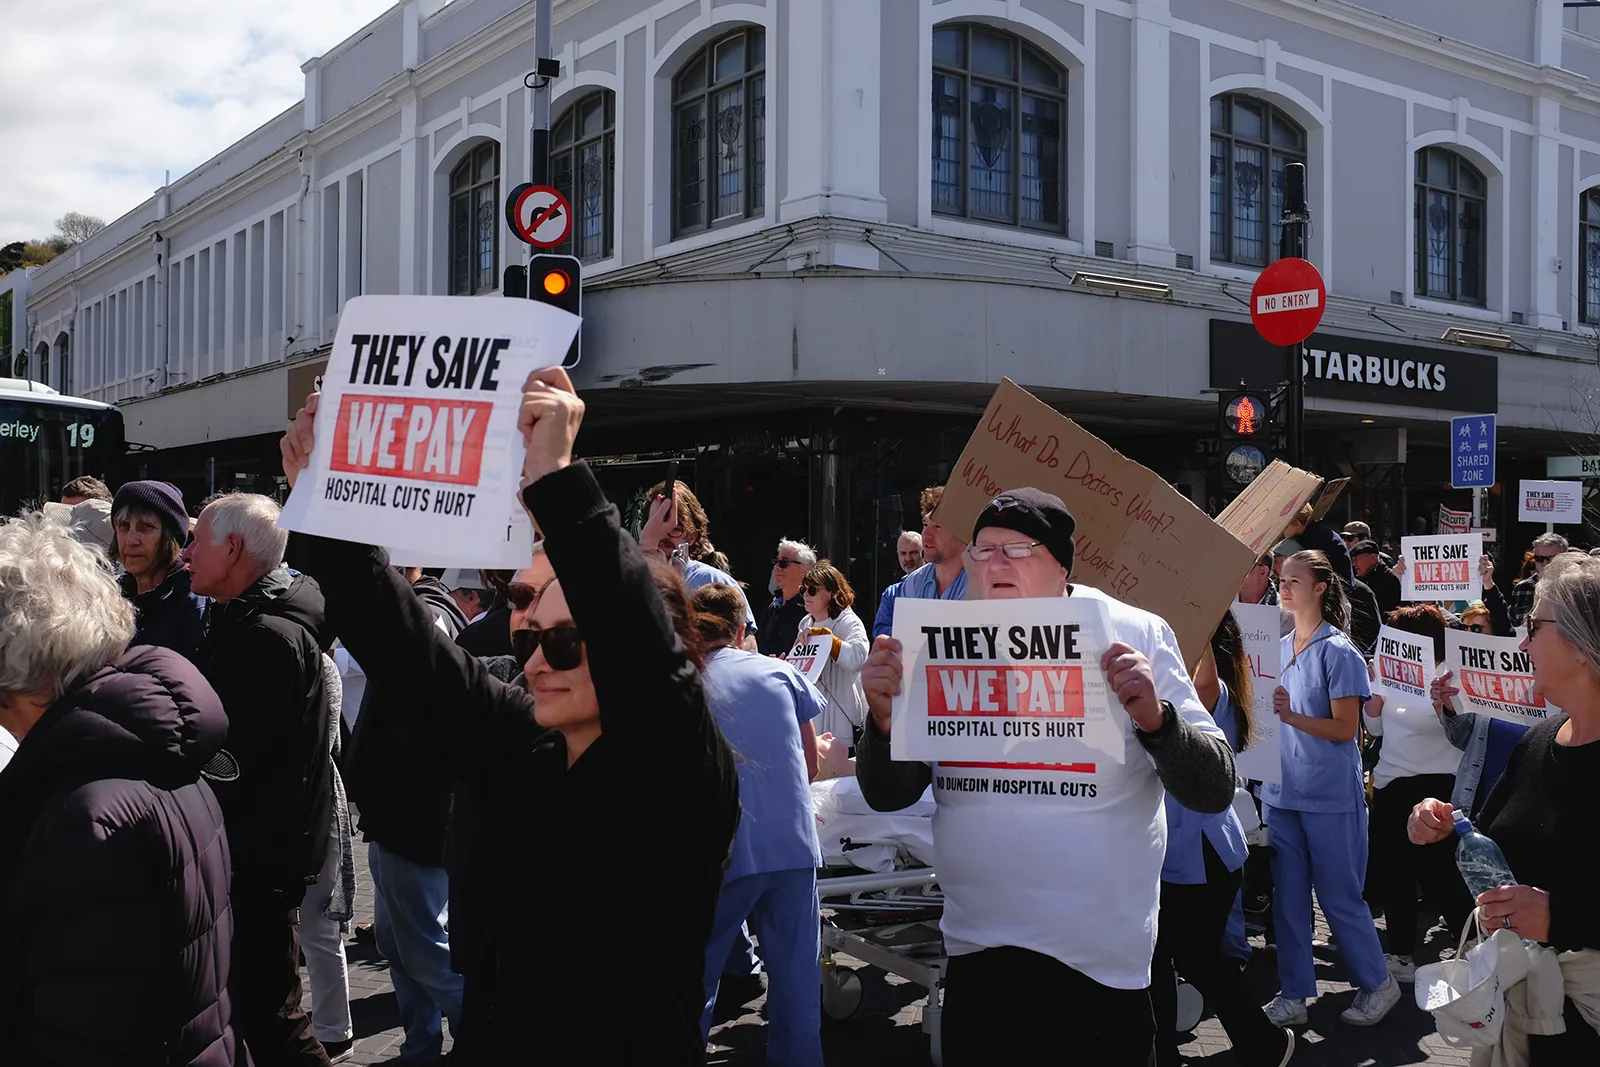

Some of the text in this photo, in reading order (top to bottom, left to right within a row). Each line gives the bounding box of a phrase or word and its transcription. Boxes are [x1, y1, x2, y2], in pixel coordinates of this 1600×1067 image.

[1264, 293, 1310, 310] NO ENTRY
[349, 334, 511, 391] THEY SAVE
[0, 420, 39, 442] erley
[66, 422, 95, 448] 19
[347, 402, 477, 477] WE PAY
[1457, 454, 1490, 467] SHARED
[988, 403, 1175, 541] What Do Doctors Want?
[1462, 470, 1483, 481] ZONE
[324, 478, 476, 517] HOSPITAL CUTS HURT
[1541, 491, 1554, 499] SAVE
[1450, 516, 1465, 524] CUTS
[1412, 544, 1468, 560] THEY SAVE
[1110, 564, 1139, 599] It?
[1418, 562, 1464, 581] WE PAY
[1455, 583, 1470, 591] HURT
[921, 625, 998, 660] THEY
[1008, 624, 1082, 660] SAVE
[1242, 629, 1271, 642] nedin
[793, 644, 819, 657] SAVE
[1381, 636, 1422, 662] THEY SAVE
[1459, 645, 1533, 673] THEY SAV
[1382, 657, 1420, 685] WE PAY
[938, 669, 1069, 712] WE PAY
[1381, 678, 1425, 697] HOSPITAL CUTS HURT
[1466, 672, 1536, 705] WE PAY
[1468, 696, 1547, 719] HOSPITAL CUTS HURT
[927, 720, 1085, 737] HOSPITAL CUTS HURT
[946, 777, 989, 792] DUNEDIN
[992, 779, 1057, 796] HOSPITAL
[1060, 781, 1097, 798] CUTS
